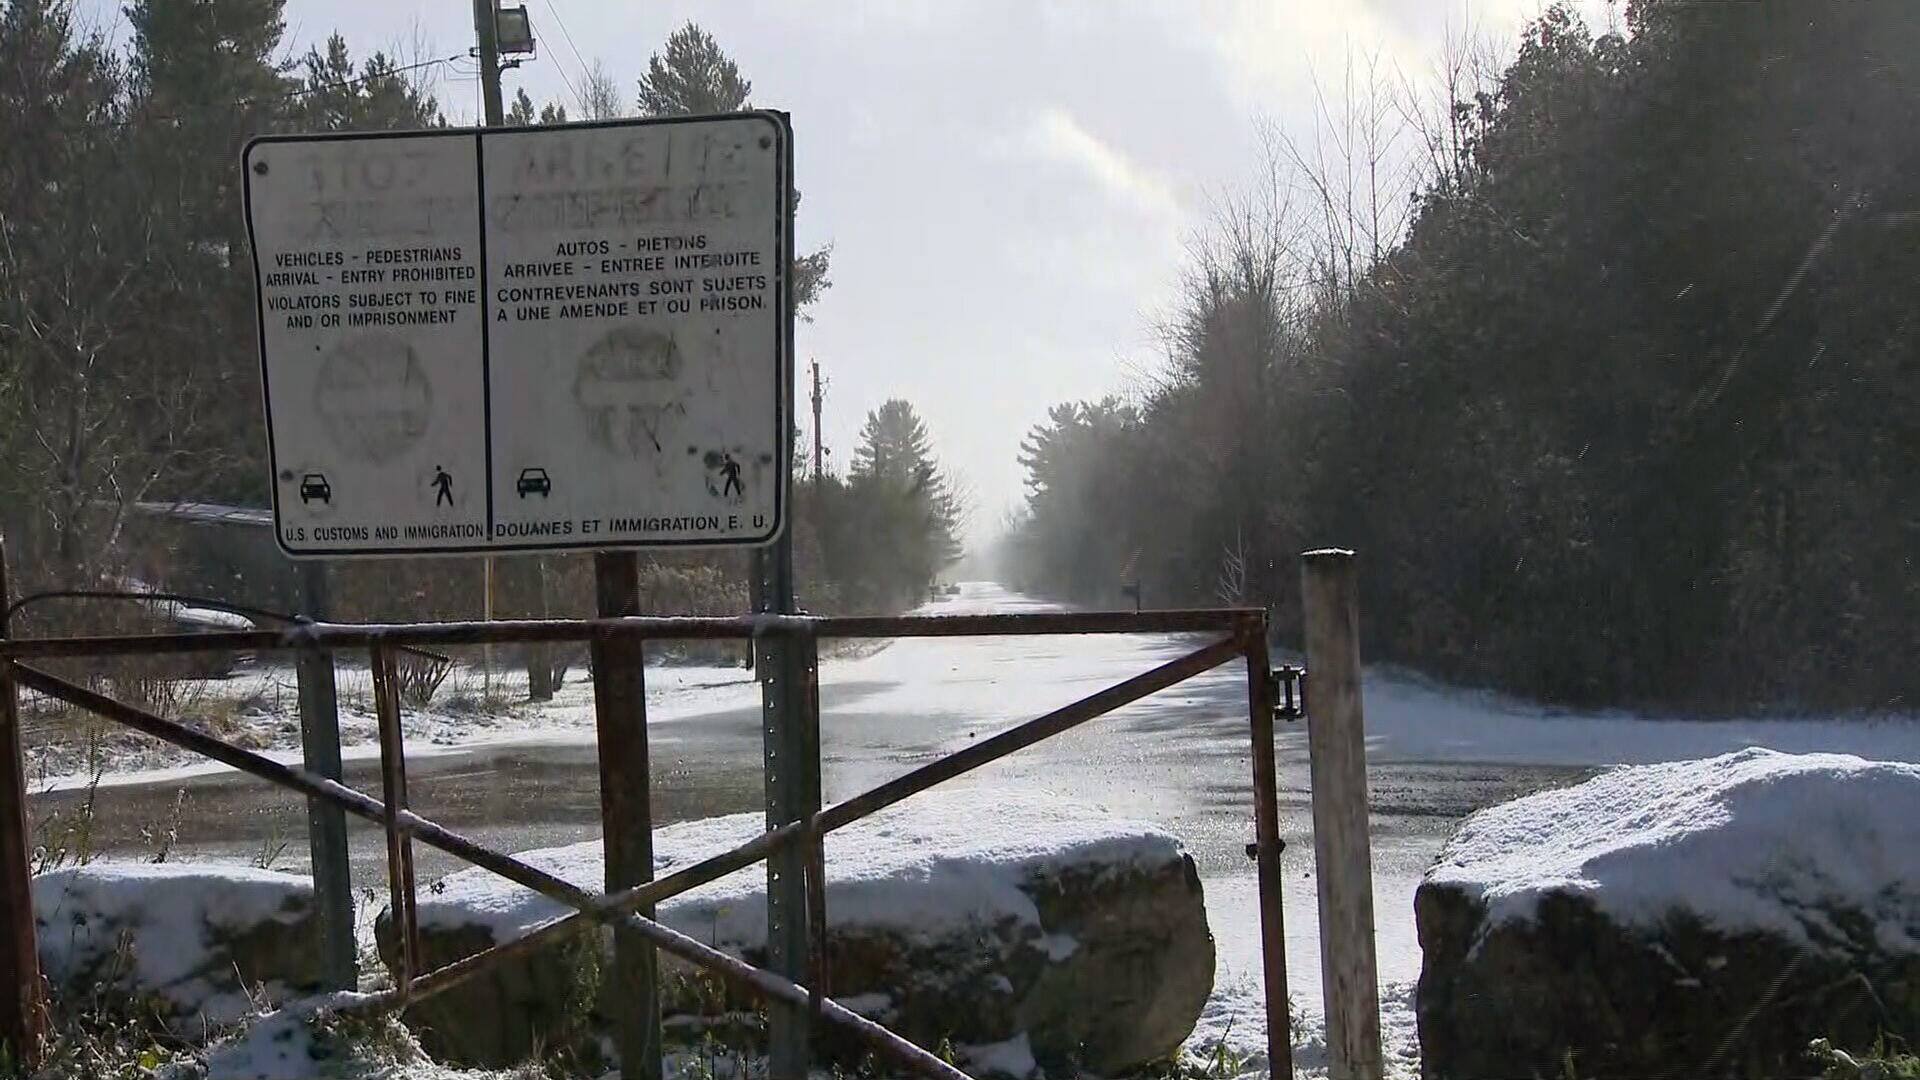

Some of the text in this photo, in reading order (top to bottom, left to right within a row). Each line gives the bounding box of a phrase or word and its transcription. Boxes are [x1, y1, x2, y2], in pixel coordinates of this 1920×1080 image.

[556, 240, 609, 257] AUTOS
[637, 235, 707, 251] PIETONS
[276, 252, 344, 267] VEHICLES
[366, 247, 462, 264] PEDESTRIANS
[504, 262, 573, 278] ARRIVEE
[601, 256, 665, 273] ENTREE
[675, 251, 760, 269] INTERDITE
[265, 271, 319, 287] ARRIVAL
[341, 270, 385, 284] ENTRY
[392, 266, 476, 282] PROHIBITED
[497, 275, 766, 303] CONTREVENANTS SONT SUJETS
[267, 290, 476, 311] VIOLATORS SUBJECT TO FINE
[497, 308, 507, 322] A
[516, 306, 550, 320] UNE
[559, 302, 628, 319] AMENDE
[638, 301, 657, 314] ET
[667, 299, 690, 314] OU
[348, 310, 457, 326] IMPRISONMENT
[314, 526, 369, 541] CUSTOMS
[375, 525, 398, 540] AND
[404, 523, 483, 539] IMMIGRATION
[496, 521, 573, 537] DOUANES
[582, 520, 601, 534] ET
[609, 516, 718, 533] IMMIGRATION
